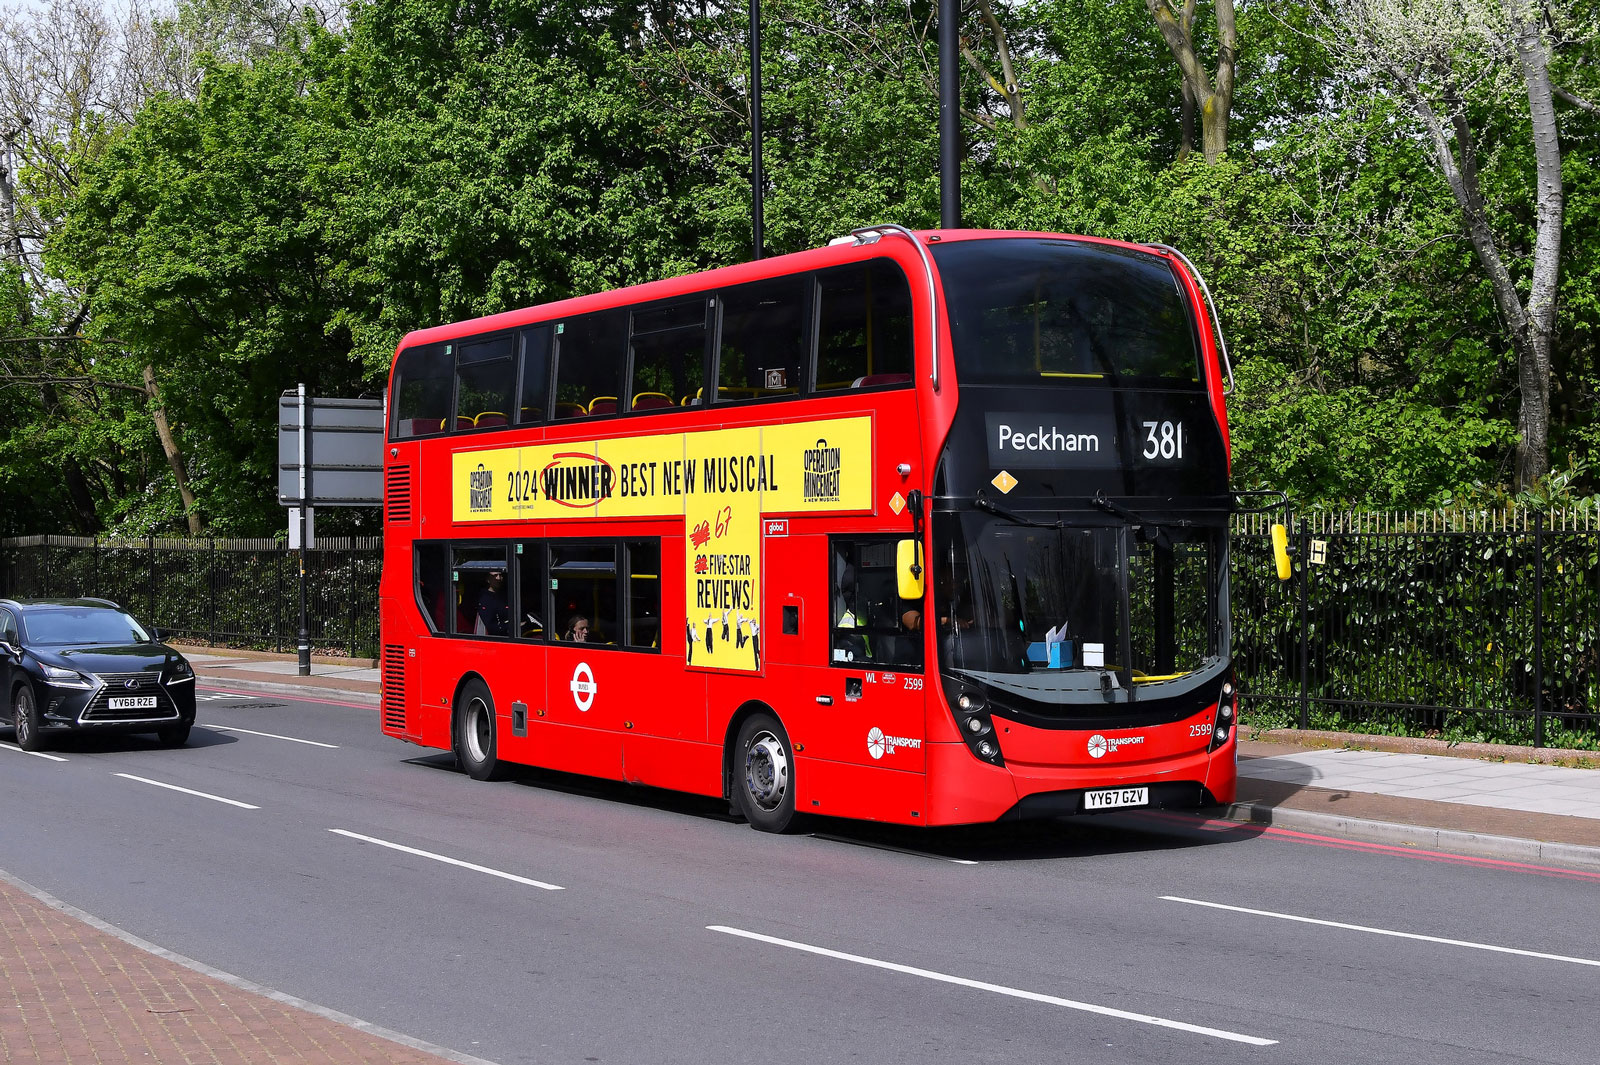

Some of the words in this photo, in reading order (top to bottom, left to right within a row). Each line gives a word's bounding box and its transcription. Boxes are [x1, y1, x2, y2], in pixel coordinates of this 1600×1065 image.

[999, 424, 1099, 452] Peckham
[1142, 420, 1183, 460] 381
[804, 447, 841, 474] OPERATION
[507, 470, 538, 502] 2024
[543, 464, 612, 501] WINNER
[620, 462, 657, 498] BEST
[663, 459, 697, 495] NEW
[703, 454, 778, 494] MUSICAL
[804, 470, 840, 498] MINCEMEAT
[768, 522, 783, 534] global
[1311, 542, 1324, 562] H
[709, 554, 751, 576] FIVE-STAR
[697, 579, 755, 611] REVIEWS!
[865, 672, 877, 683] WL
[903, 677, 922, 690] 2599
[113, 698, 135, 707] YV68
[137, 697, 154, 706] RZE
[1189, 723, 1211, 736] 2599
[885, 735, 921, 748] TRANSPORT
[1107, 736, 1144, 745] TRANSPORT
[1108, 744, 1117, 752] UK
[885, 745, 894, 754] UK
[1090, 791, 1120, 806] YY67
[1122, 789, 1142, 803] GZV
